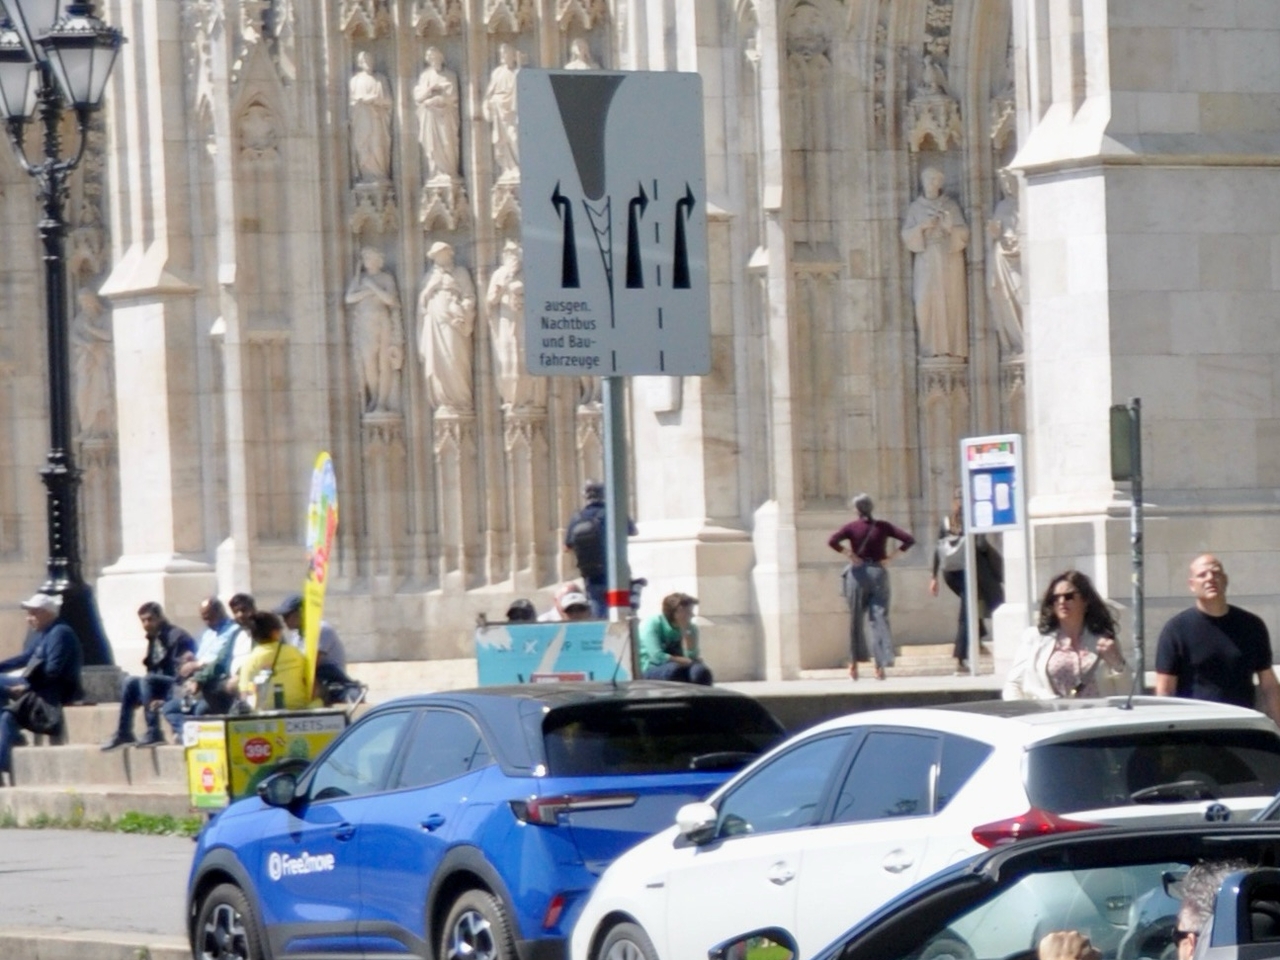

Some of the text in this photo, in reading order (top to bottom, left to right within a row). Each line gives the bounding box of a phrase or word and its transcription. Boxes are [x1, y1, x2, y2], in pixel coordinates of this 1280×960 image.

[545, 300, 591, 315] ausgen.
[541, 316, 596, 330] Nachtbus
[542, 335, 597, 348] und Bau-
[540, 353, 600, 369] fahrzeuge
